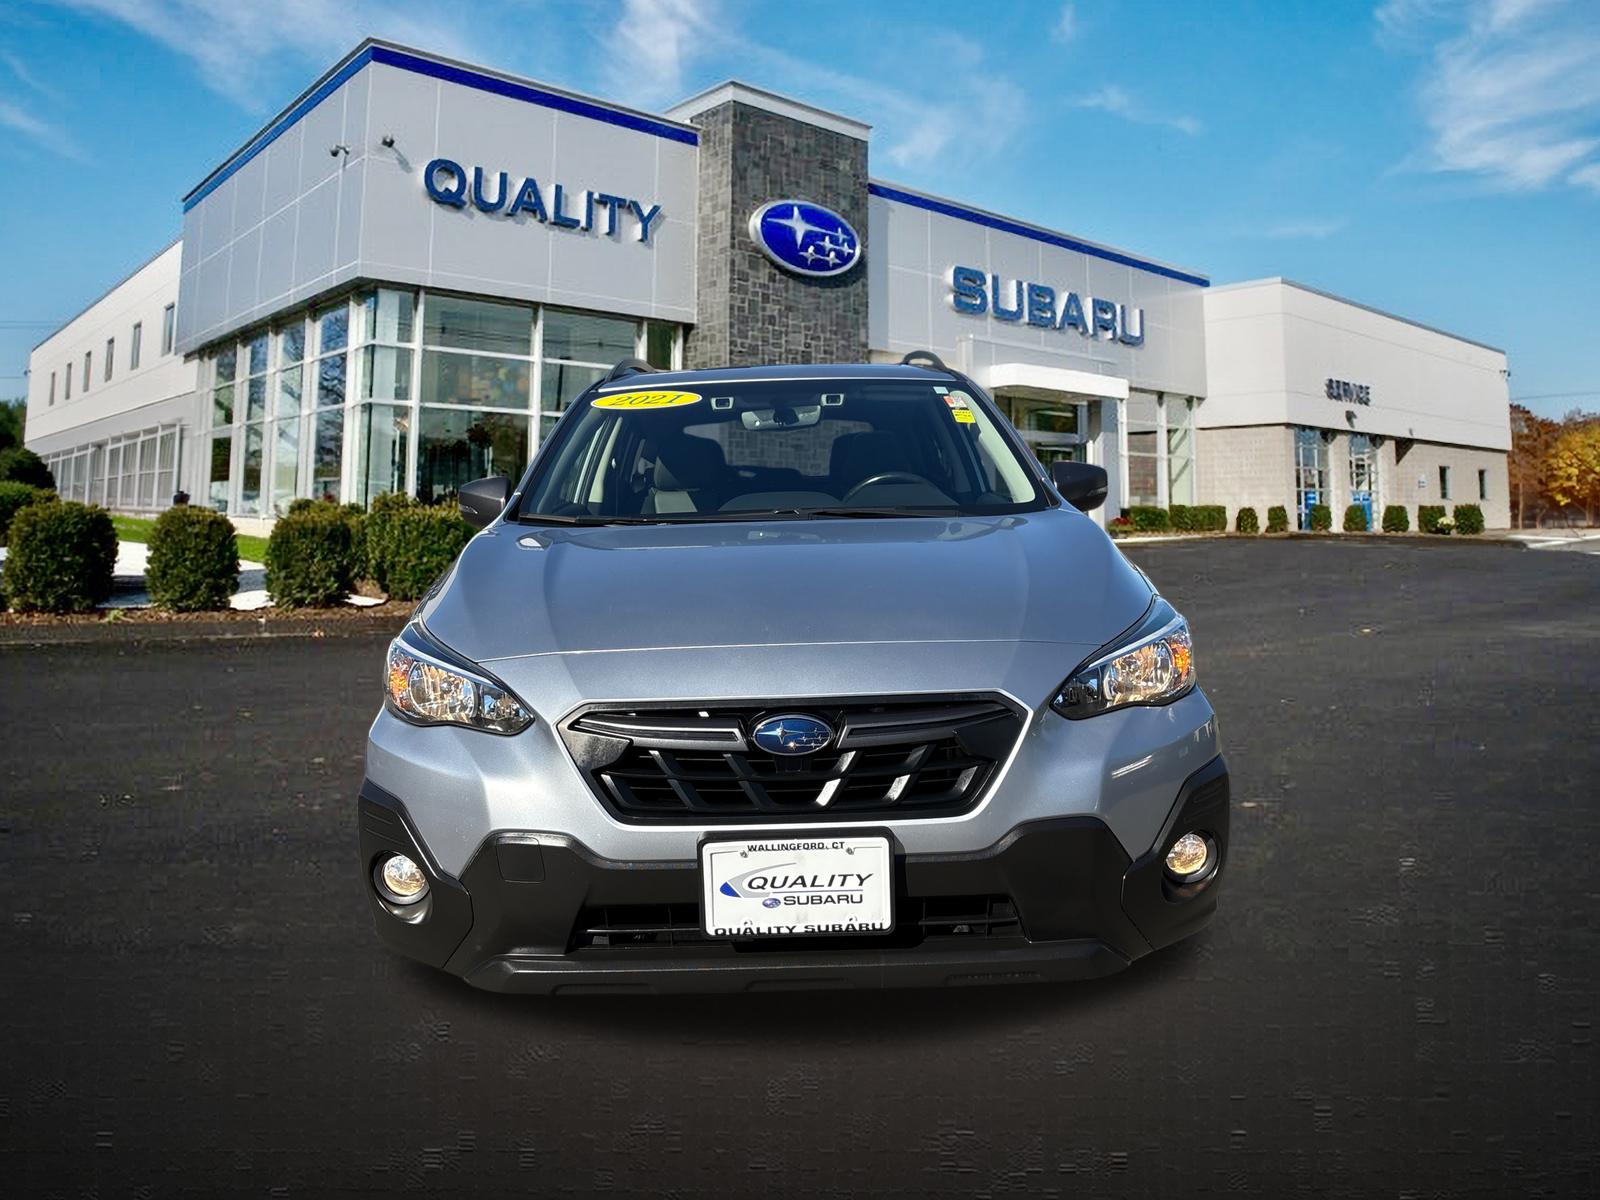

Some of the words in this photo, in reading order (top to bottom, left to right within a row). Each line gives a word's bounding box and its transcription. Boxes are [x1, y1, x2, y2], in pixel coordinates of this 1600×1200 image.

[424, 158, 661, 243] QUALITY
[948, 265, 1145, 346] SUBARU
[609, 394, 685, 407] 2021
[747, 873, 874, 890] QUALITY
[783, 894, 863, 905] SUBARU
[714, 925, 798, 936] QUALITY
[804, 922, 884, 933] SUBARU
